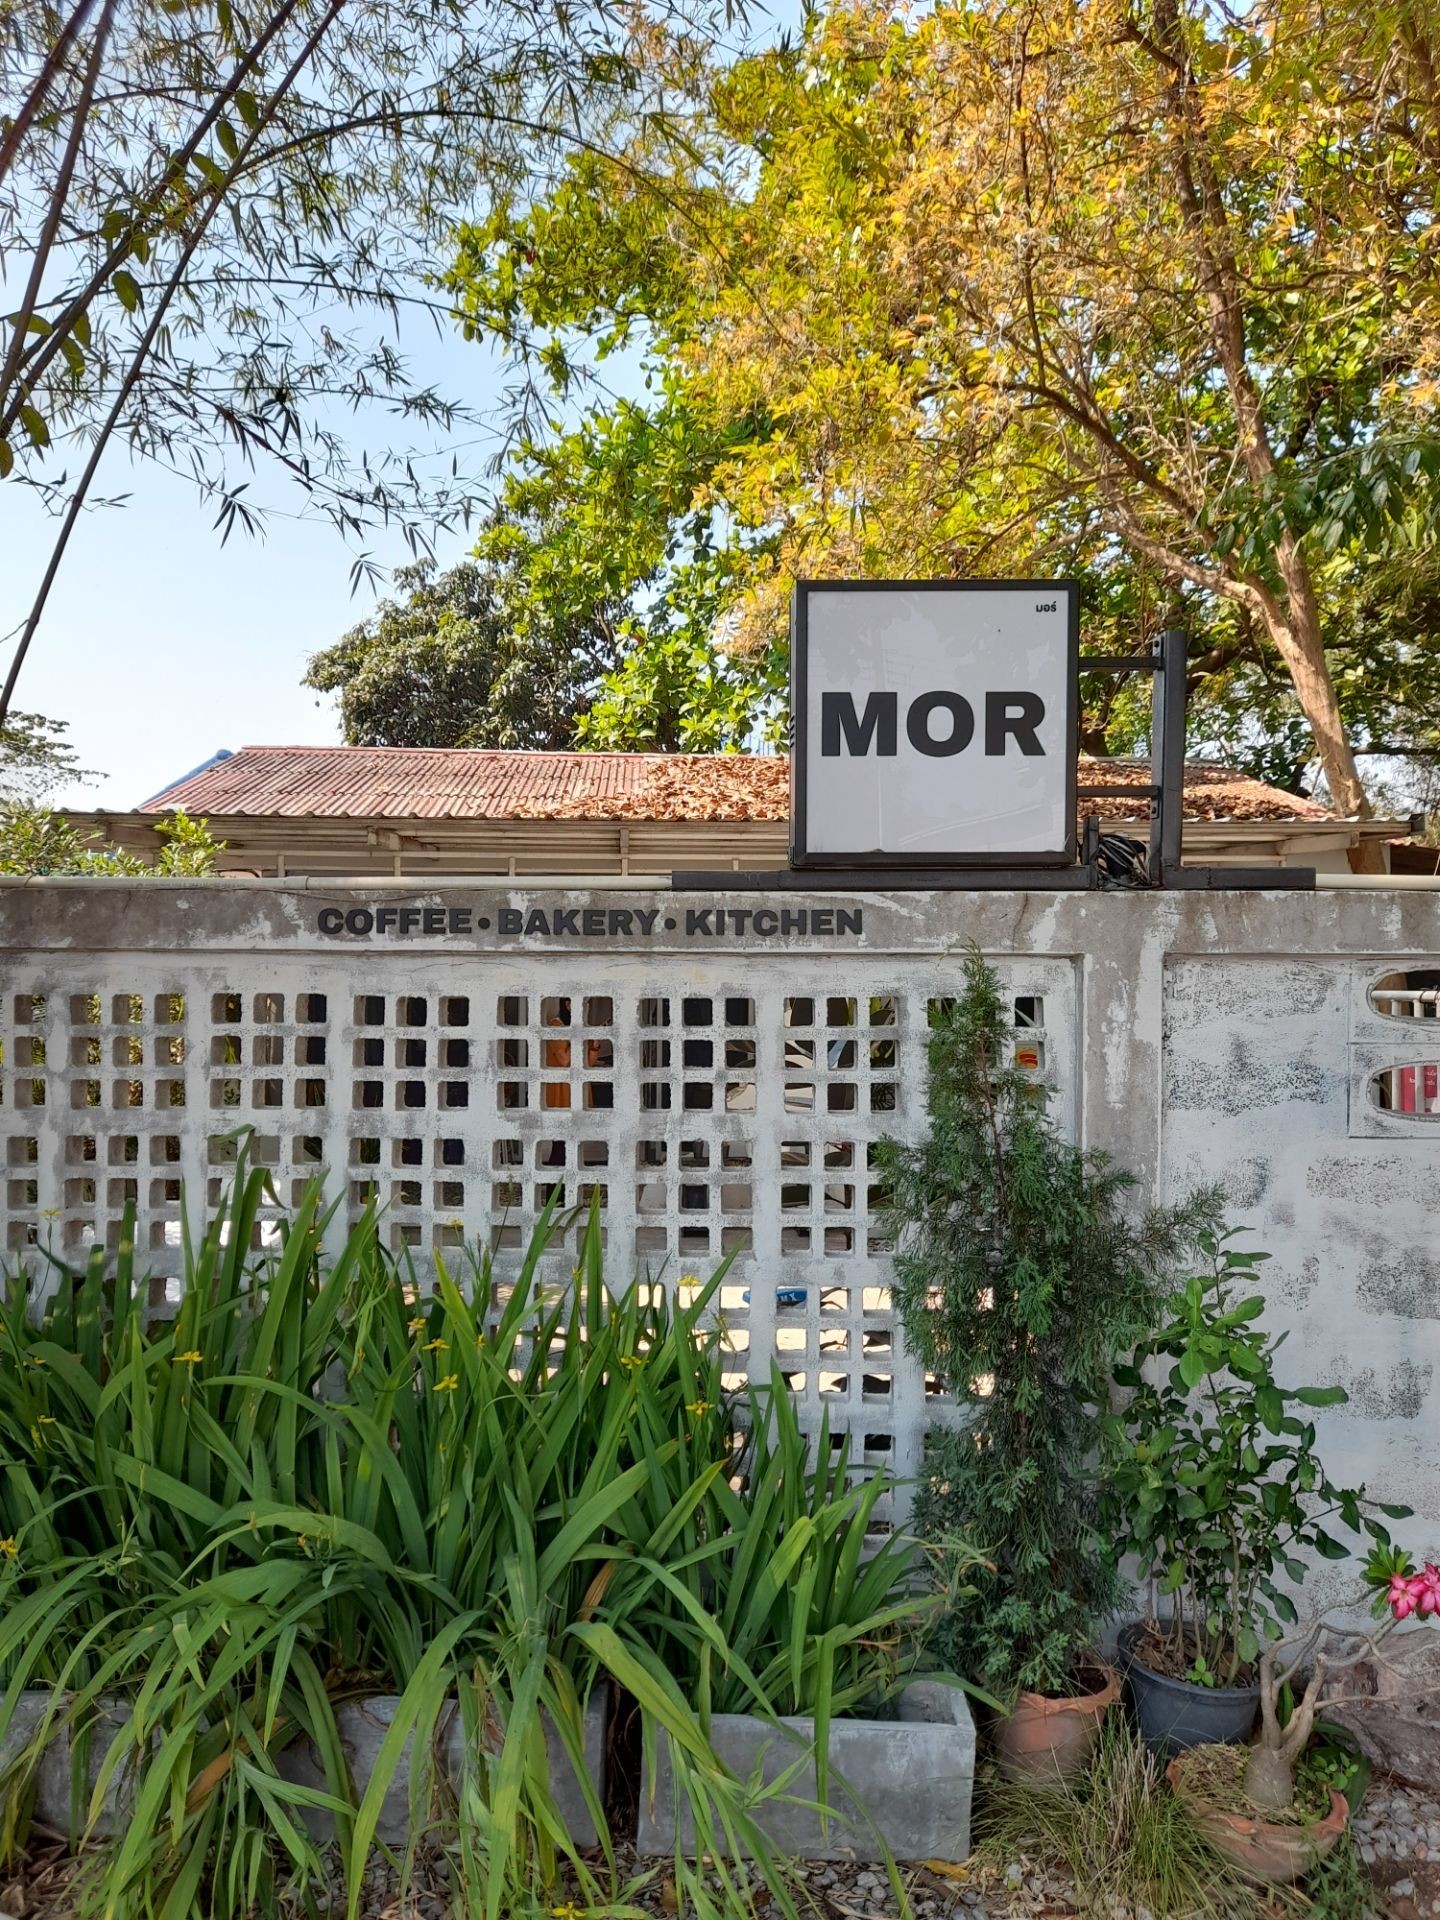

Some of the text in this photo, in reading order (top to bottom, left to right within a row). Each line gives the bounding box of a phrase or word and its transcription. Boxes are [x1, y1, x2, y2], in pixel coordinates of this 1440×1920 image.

[1036, 600, 1057, 613] มอร์
[821, 690, 1046, 758] MOR
[317, 908, 863, 937] COFFEE BAKERY KITCHEN
